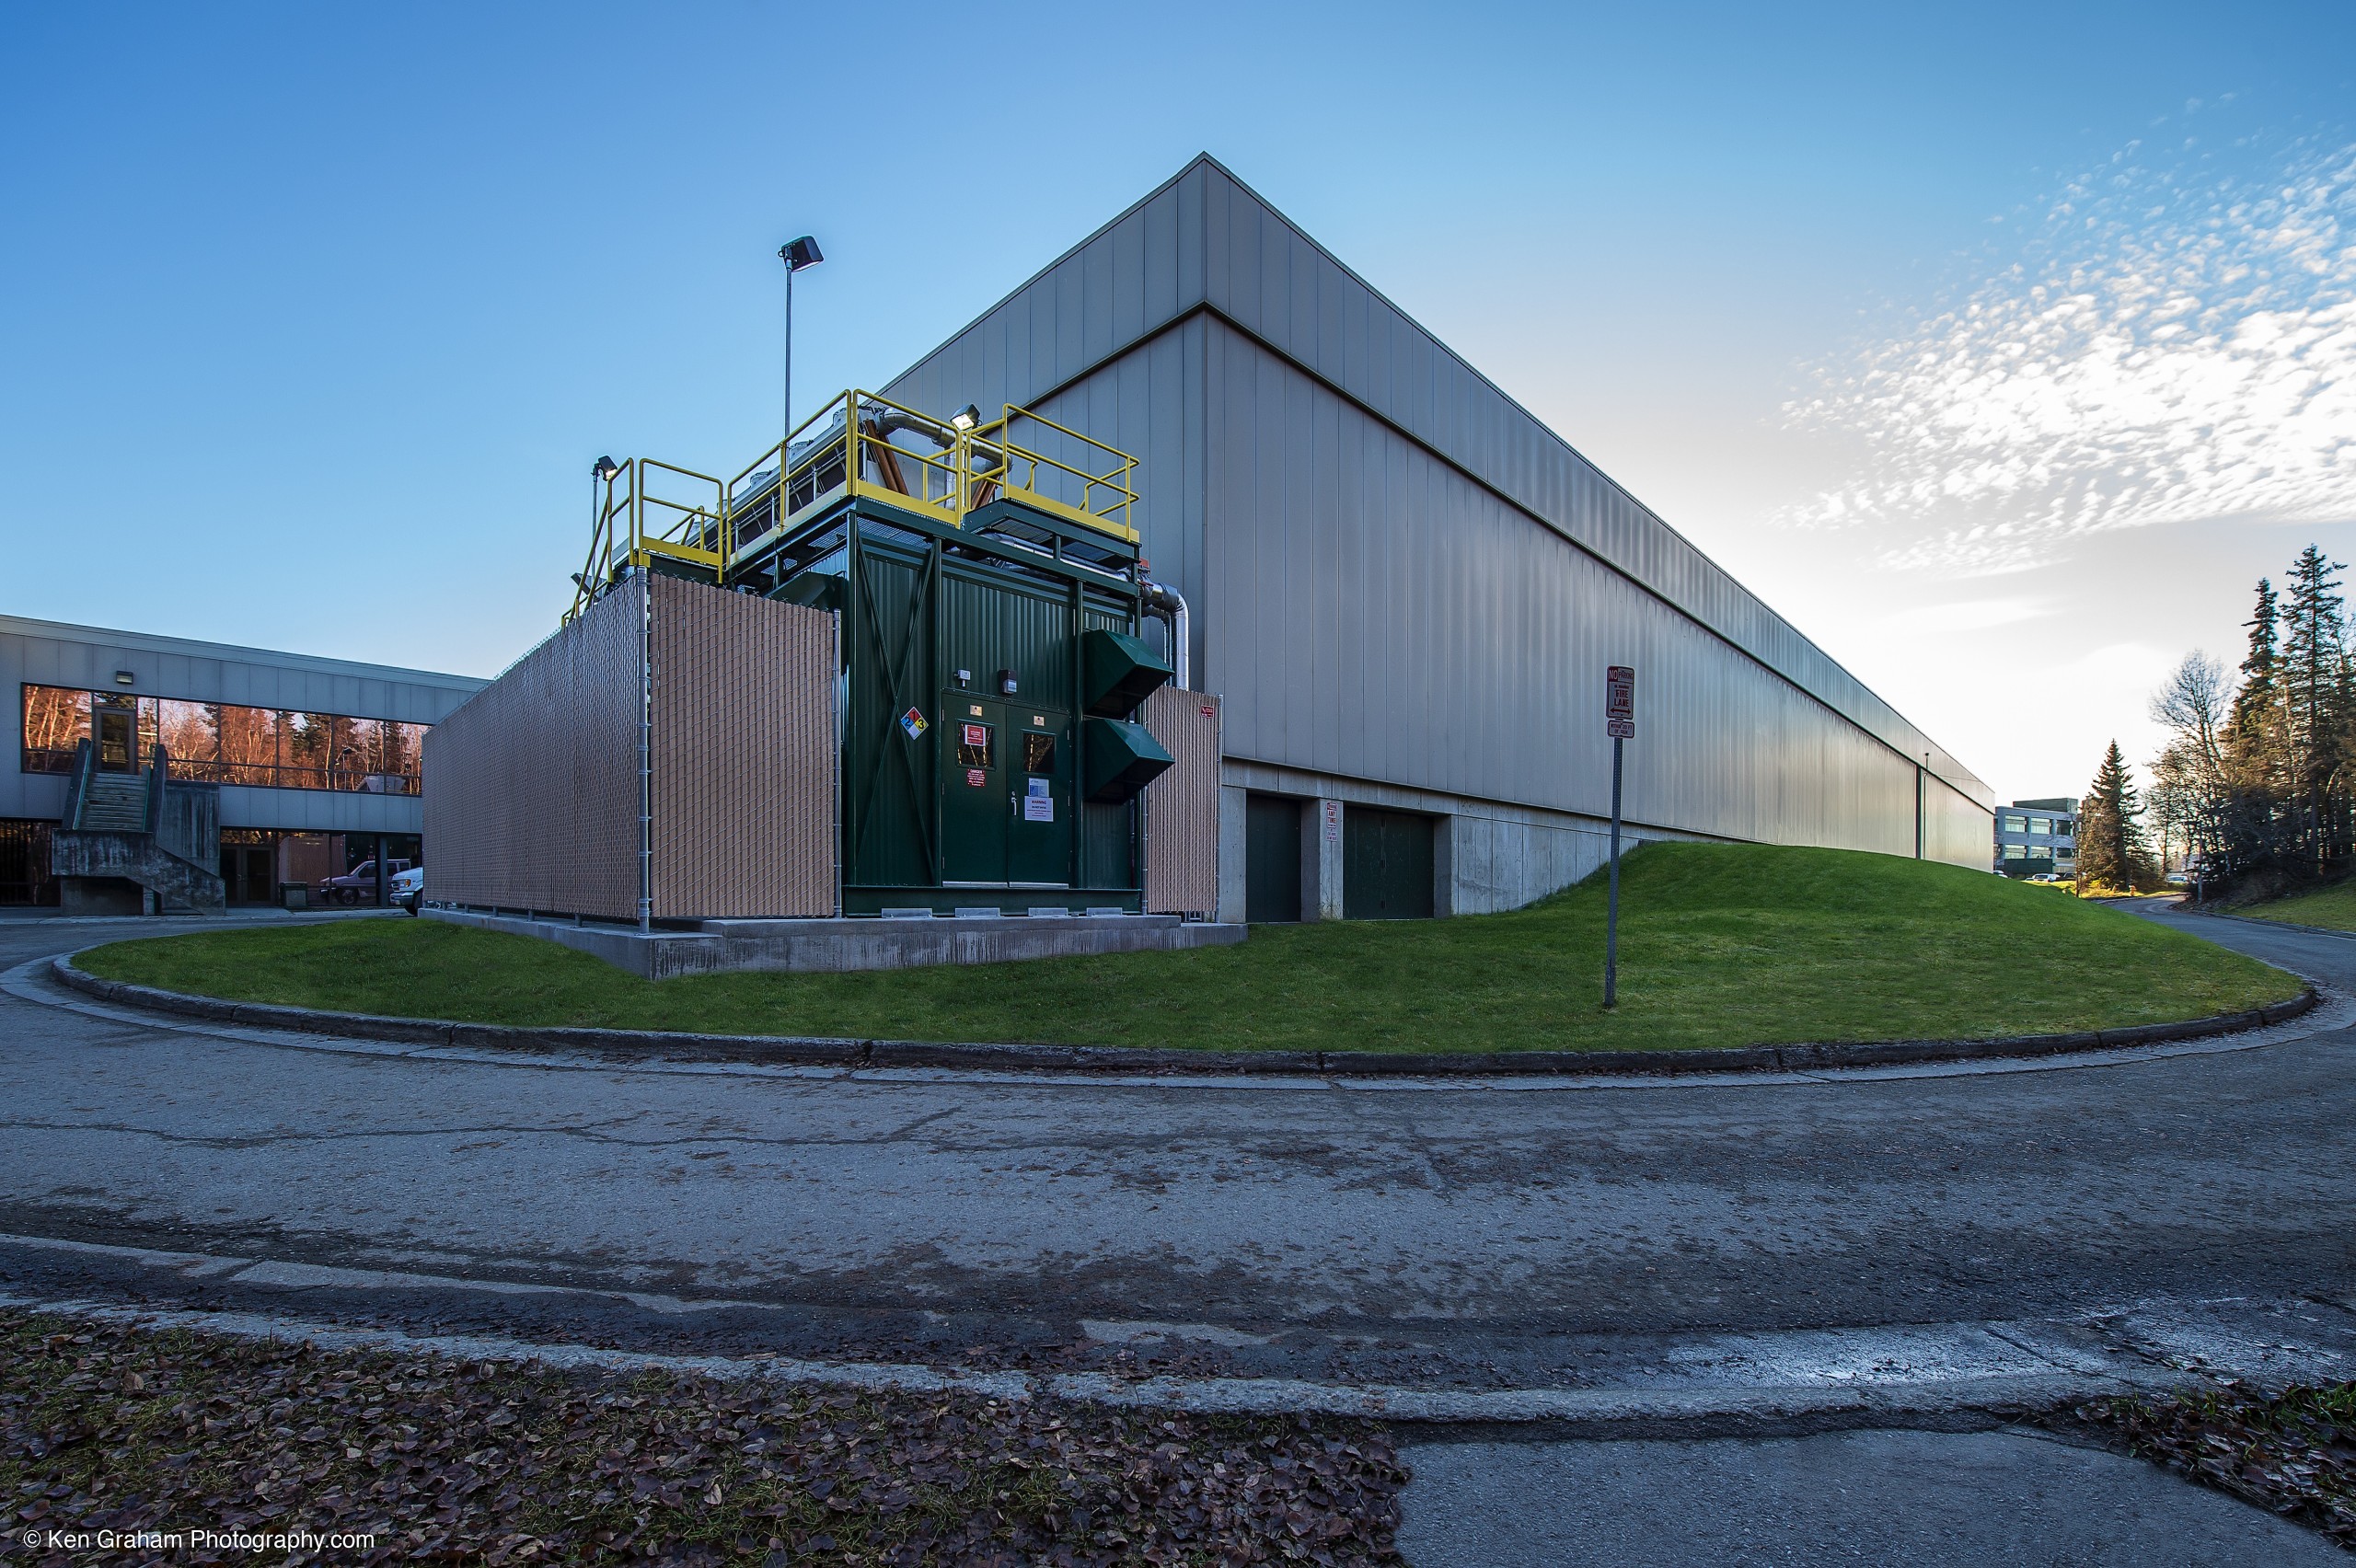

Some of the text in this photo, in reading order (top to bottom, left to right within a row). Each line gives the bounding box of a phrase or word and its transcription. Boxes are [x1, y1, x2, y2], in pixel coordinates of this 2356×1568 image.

[1609, 669, 1634, 680] NO PARKING
[1615, 689, 1629, 698] FIRE
[1613, 698, 1629, 708] LANE
[918, 720, 924, 729] 3
